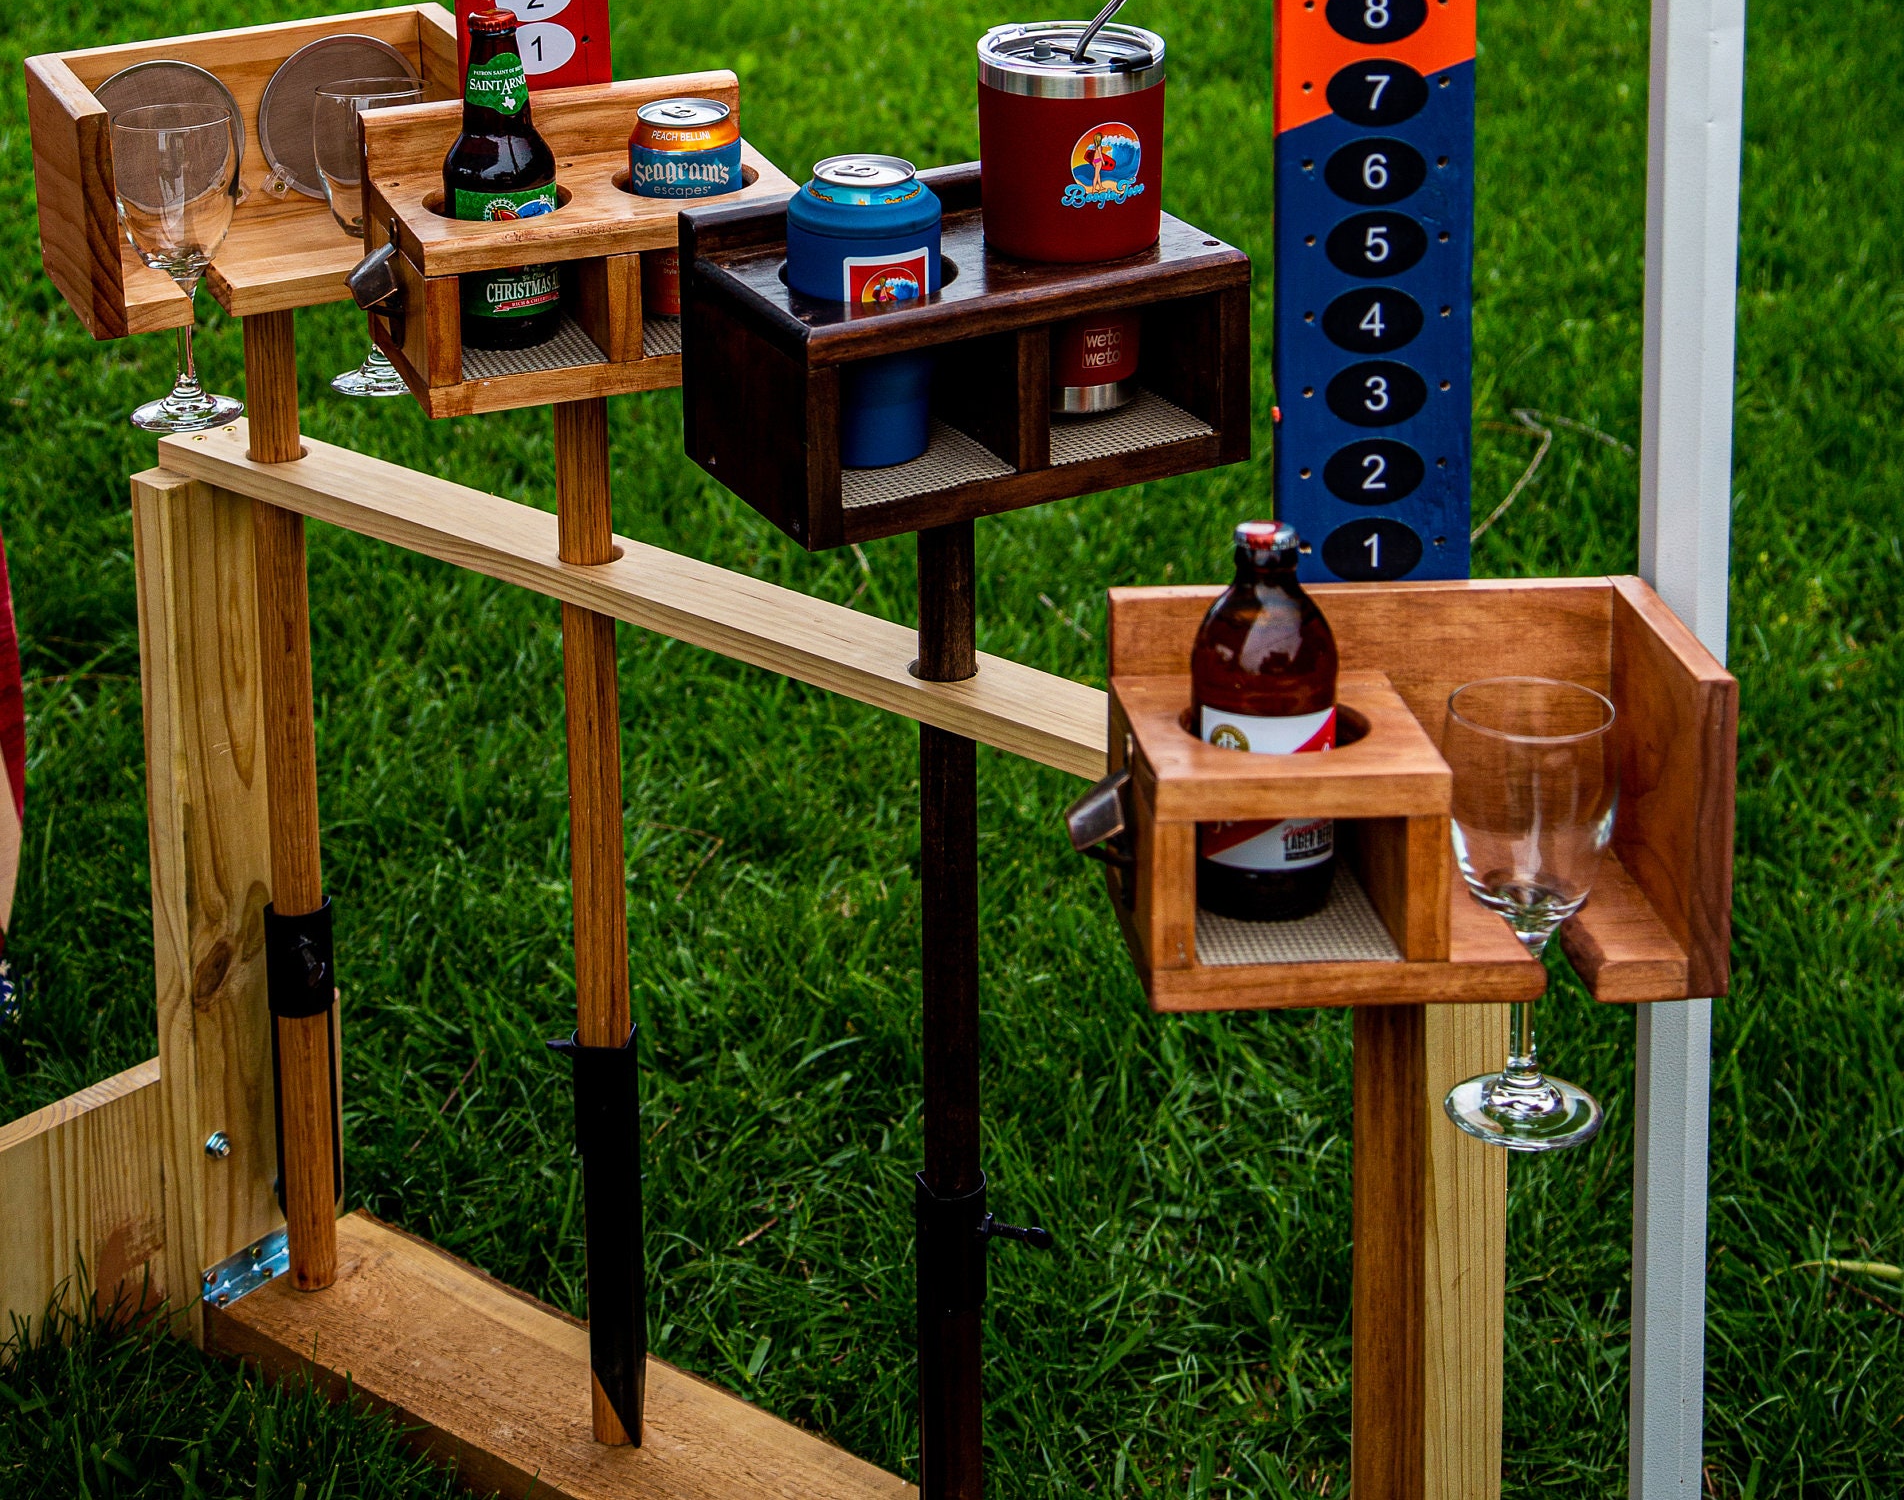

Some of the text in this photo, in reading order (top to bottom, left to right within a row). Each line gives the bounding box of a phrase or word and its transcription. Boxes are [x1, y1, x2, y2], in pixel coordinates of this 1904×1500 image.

[530, 35, 543, 62] 1
[470, 78, 502, 91] SAINT
[1366, 75, 1390, 109] 7
[651, 130, 711, 142] PEACH BELLINI
[634, 161, 730, 187] Seagram's
[1364, 153, 1387, 189] 6
[1061, 183, 1119, 209] Boogie
[1366, 227, 1389, 261] 5
[486, 275, 551, 303] CHRISTMAS
[1360, 303, 1385, 337] 4
[1086, 328, 1121, 348] weto
[1085, 347, 1120, 366] weto
[1366, 377, 1388, 411] 3
[1363, 455, 1386, 489] 2
[1364, 533, 1378, 567] 1
